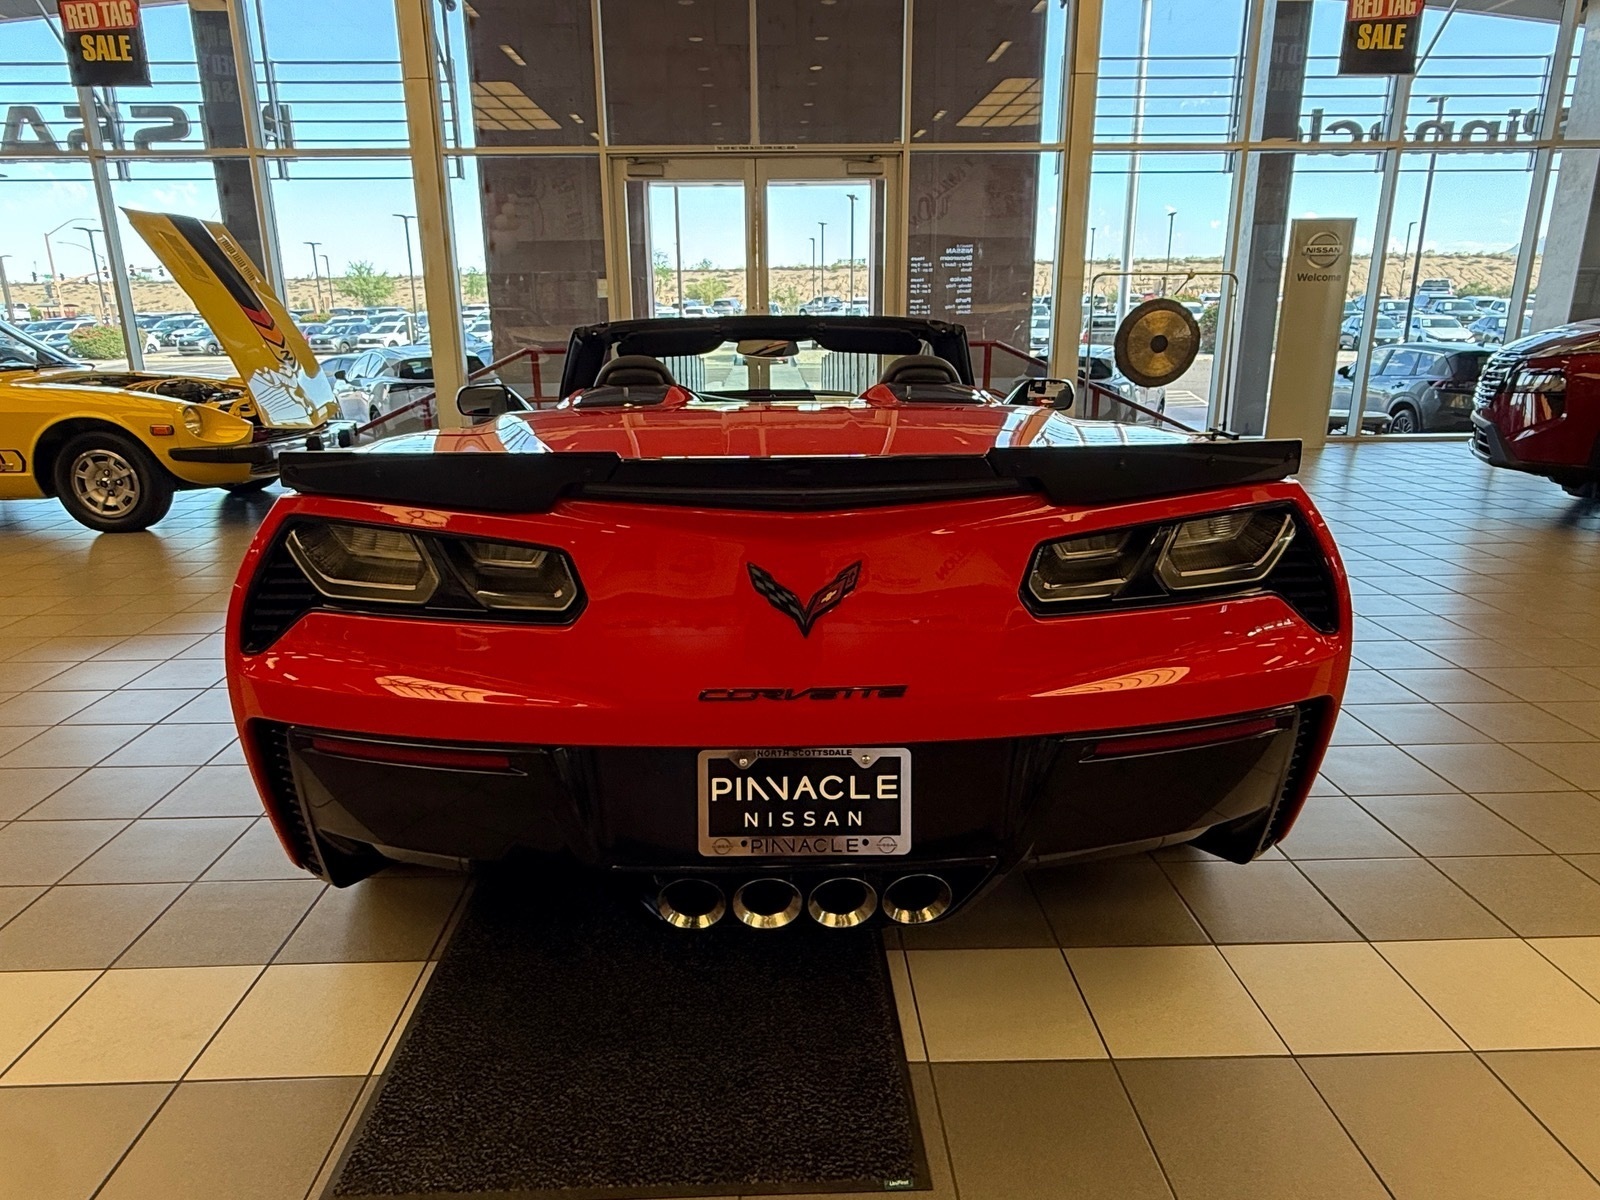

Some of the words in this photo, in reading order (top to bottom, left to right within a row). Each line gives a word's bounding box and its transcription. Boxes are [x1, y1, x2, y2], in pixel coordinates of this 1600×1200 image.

[64, 2, 99, 29] RED
[98, 0, 134, 27] TAG
[1352, 0, 1383, 18] RED
[1387, 0, 1417, 16] TAG
[1357, 23, 1407, 50] SALE
[80, 34, 133, 61] SALE
[1306, 246, 1340, 254] NISSAN
[1297, 273, 1341, 282] Welcome
[698, 685, 908, 701] CORVETTE
[757, 749, 790, 757] NORTH
[792, 749, 853, 757] SCOTTSDALE
[711, 774, 898, 802] PINNACLE
[744, 810, 862, 828] NISSAN
[751, 838, 859, 854] PINNACLE
